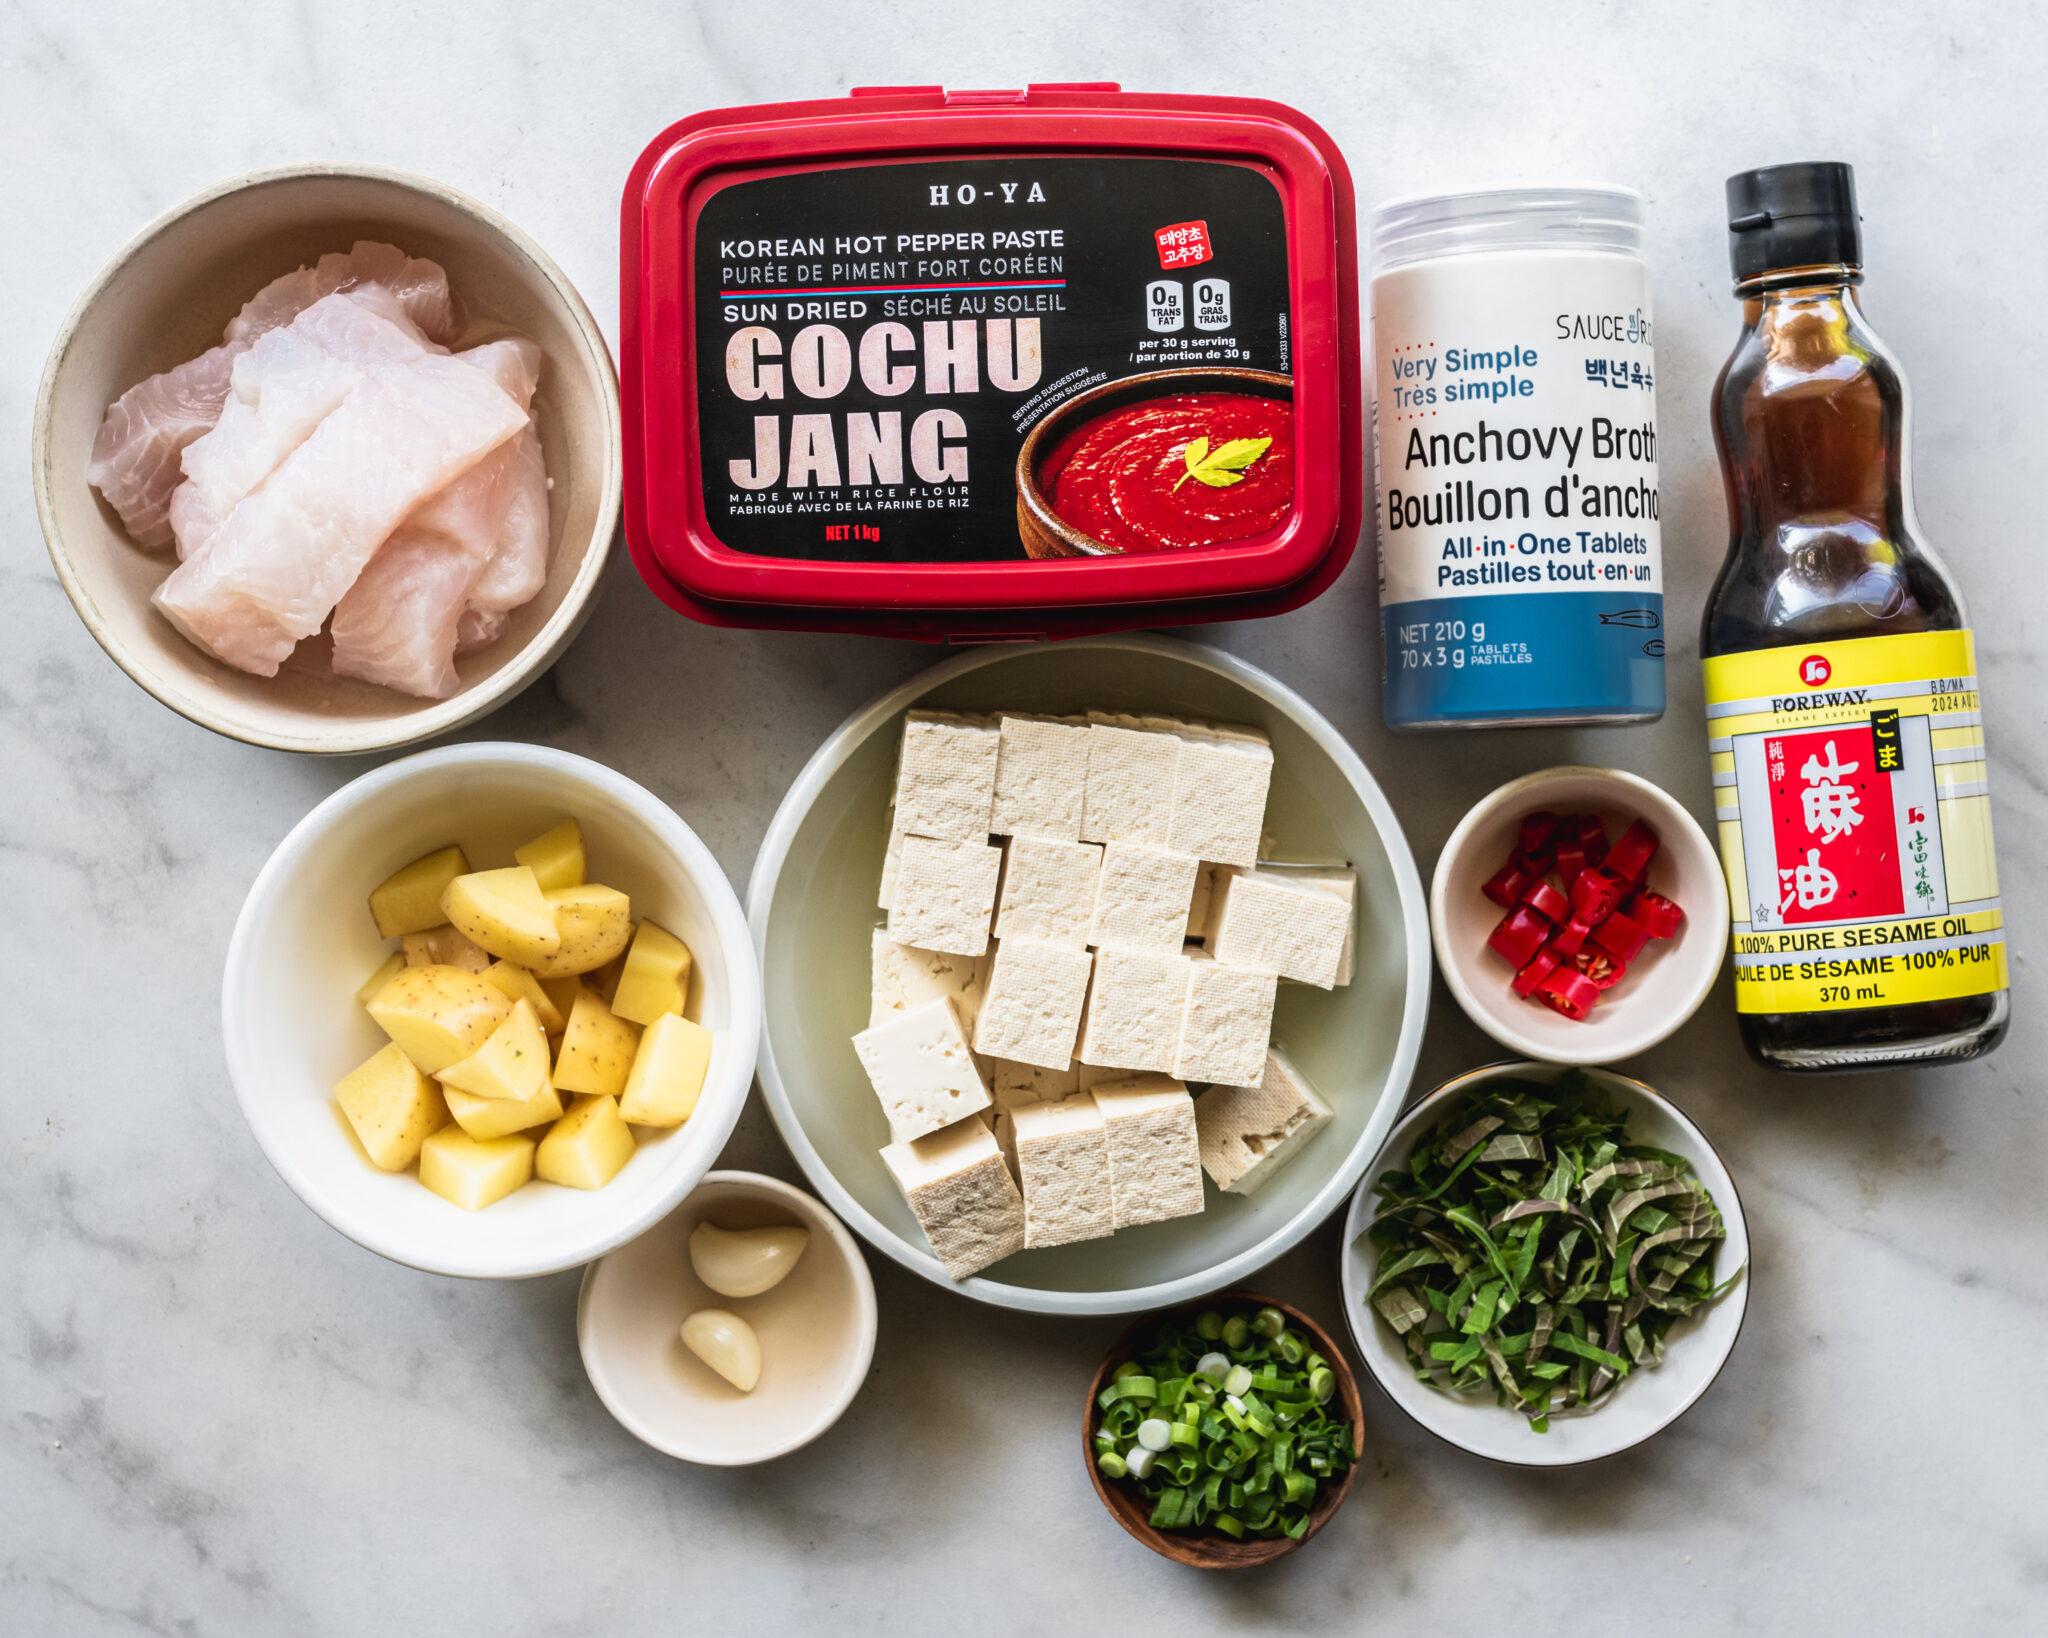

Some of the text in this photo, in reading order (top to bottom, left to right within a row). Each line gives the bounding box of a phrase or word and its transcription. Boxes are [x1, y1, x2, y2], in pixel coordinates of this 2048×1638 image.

[929, 182, 1046, 206] HO-YA
[720, 229, 1064, 259] KOREAN HOT PEPPER PASTE
[1158, 226, 1203, 246] 태양초
[1164, 243, 1205, 263] 고추장
[722, 252, 1063, 285] PURÉE DE PIMENT FORT CORÉEN
[724, 293, 1066, 323] SUN DRIED SÉCHÉ AU SOLEIL
[1151, 308, 1181, 317] TRANS
[1198, 315, 1228, 324] TRANS
[1201, 306, 1224, 315] GRAS
[1158, 317, 1175, 325] FAT
[1557, 314, 1625, 341] SAUCE
[1136, 353, 1157, 363] par
[1159, 350, 1203, 363] portion
[1206, 349, 1221, 360] de
[1224, 348, 1239, 359] 30
[1242, 350, 1250, 360] g
[1139, 336, 1236, 351] per 30 g serving
[725, 317, 1043, 401] GOCHU
[1392, 345, 1538, 381] Very Simple
[1012, 366, 1089, 421] SERVING SUGGESTION
[1393, 374, 1534, 408] Très simple
[1016, 391, 1065, 434] PRÉSENTATION
[728, 408, 969, 490] JANG
[1405, 417, 1657, 470] Anchovy Broth
[729, 486, 969, 502] MADE WITH RICE FLOUR
[1389, 480, 1530, 530] Bouillon
[730, 498, 970, 515] FABRIQUÉ AVEC DE LA FARINE DE RIZ
[825, 525, 880, 542] NET 1 kg
[1576, 532, 1647, 556] Tablets
[1438, 561, 1541, 587] Pastilles
[1400, 620, 1485, 644] NET 210 g
[1401, 647, 1465, 669] 70 x 3 g
[1470, 643, 1527, 655] TABLETS
[1471, 653, 1533, 666] PASTILLES
[1771, 689, 1867, 713] FOREWAY
[1932, 696, 1958, 711] 2024
[1776, 709, 1867, 724] SESAME EXPERT
[1876, 713, 1899, 769] ごま
[1740, 918, 1972, 954] 100% PURE SESAME OIL
[1770, 963, 1794, 980] DE
[1800, 955, 1894, 979] SÉSAME
[1902, 949, 1954, 970] 100%
[1959, 943, 1990, 964] PUR
[1820, 983, 1885, 1002] 370 mL
